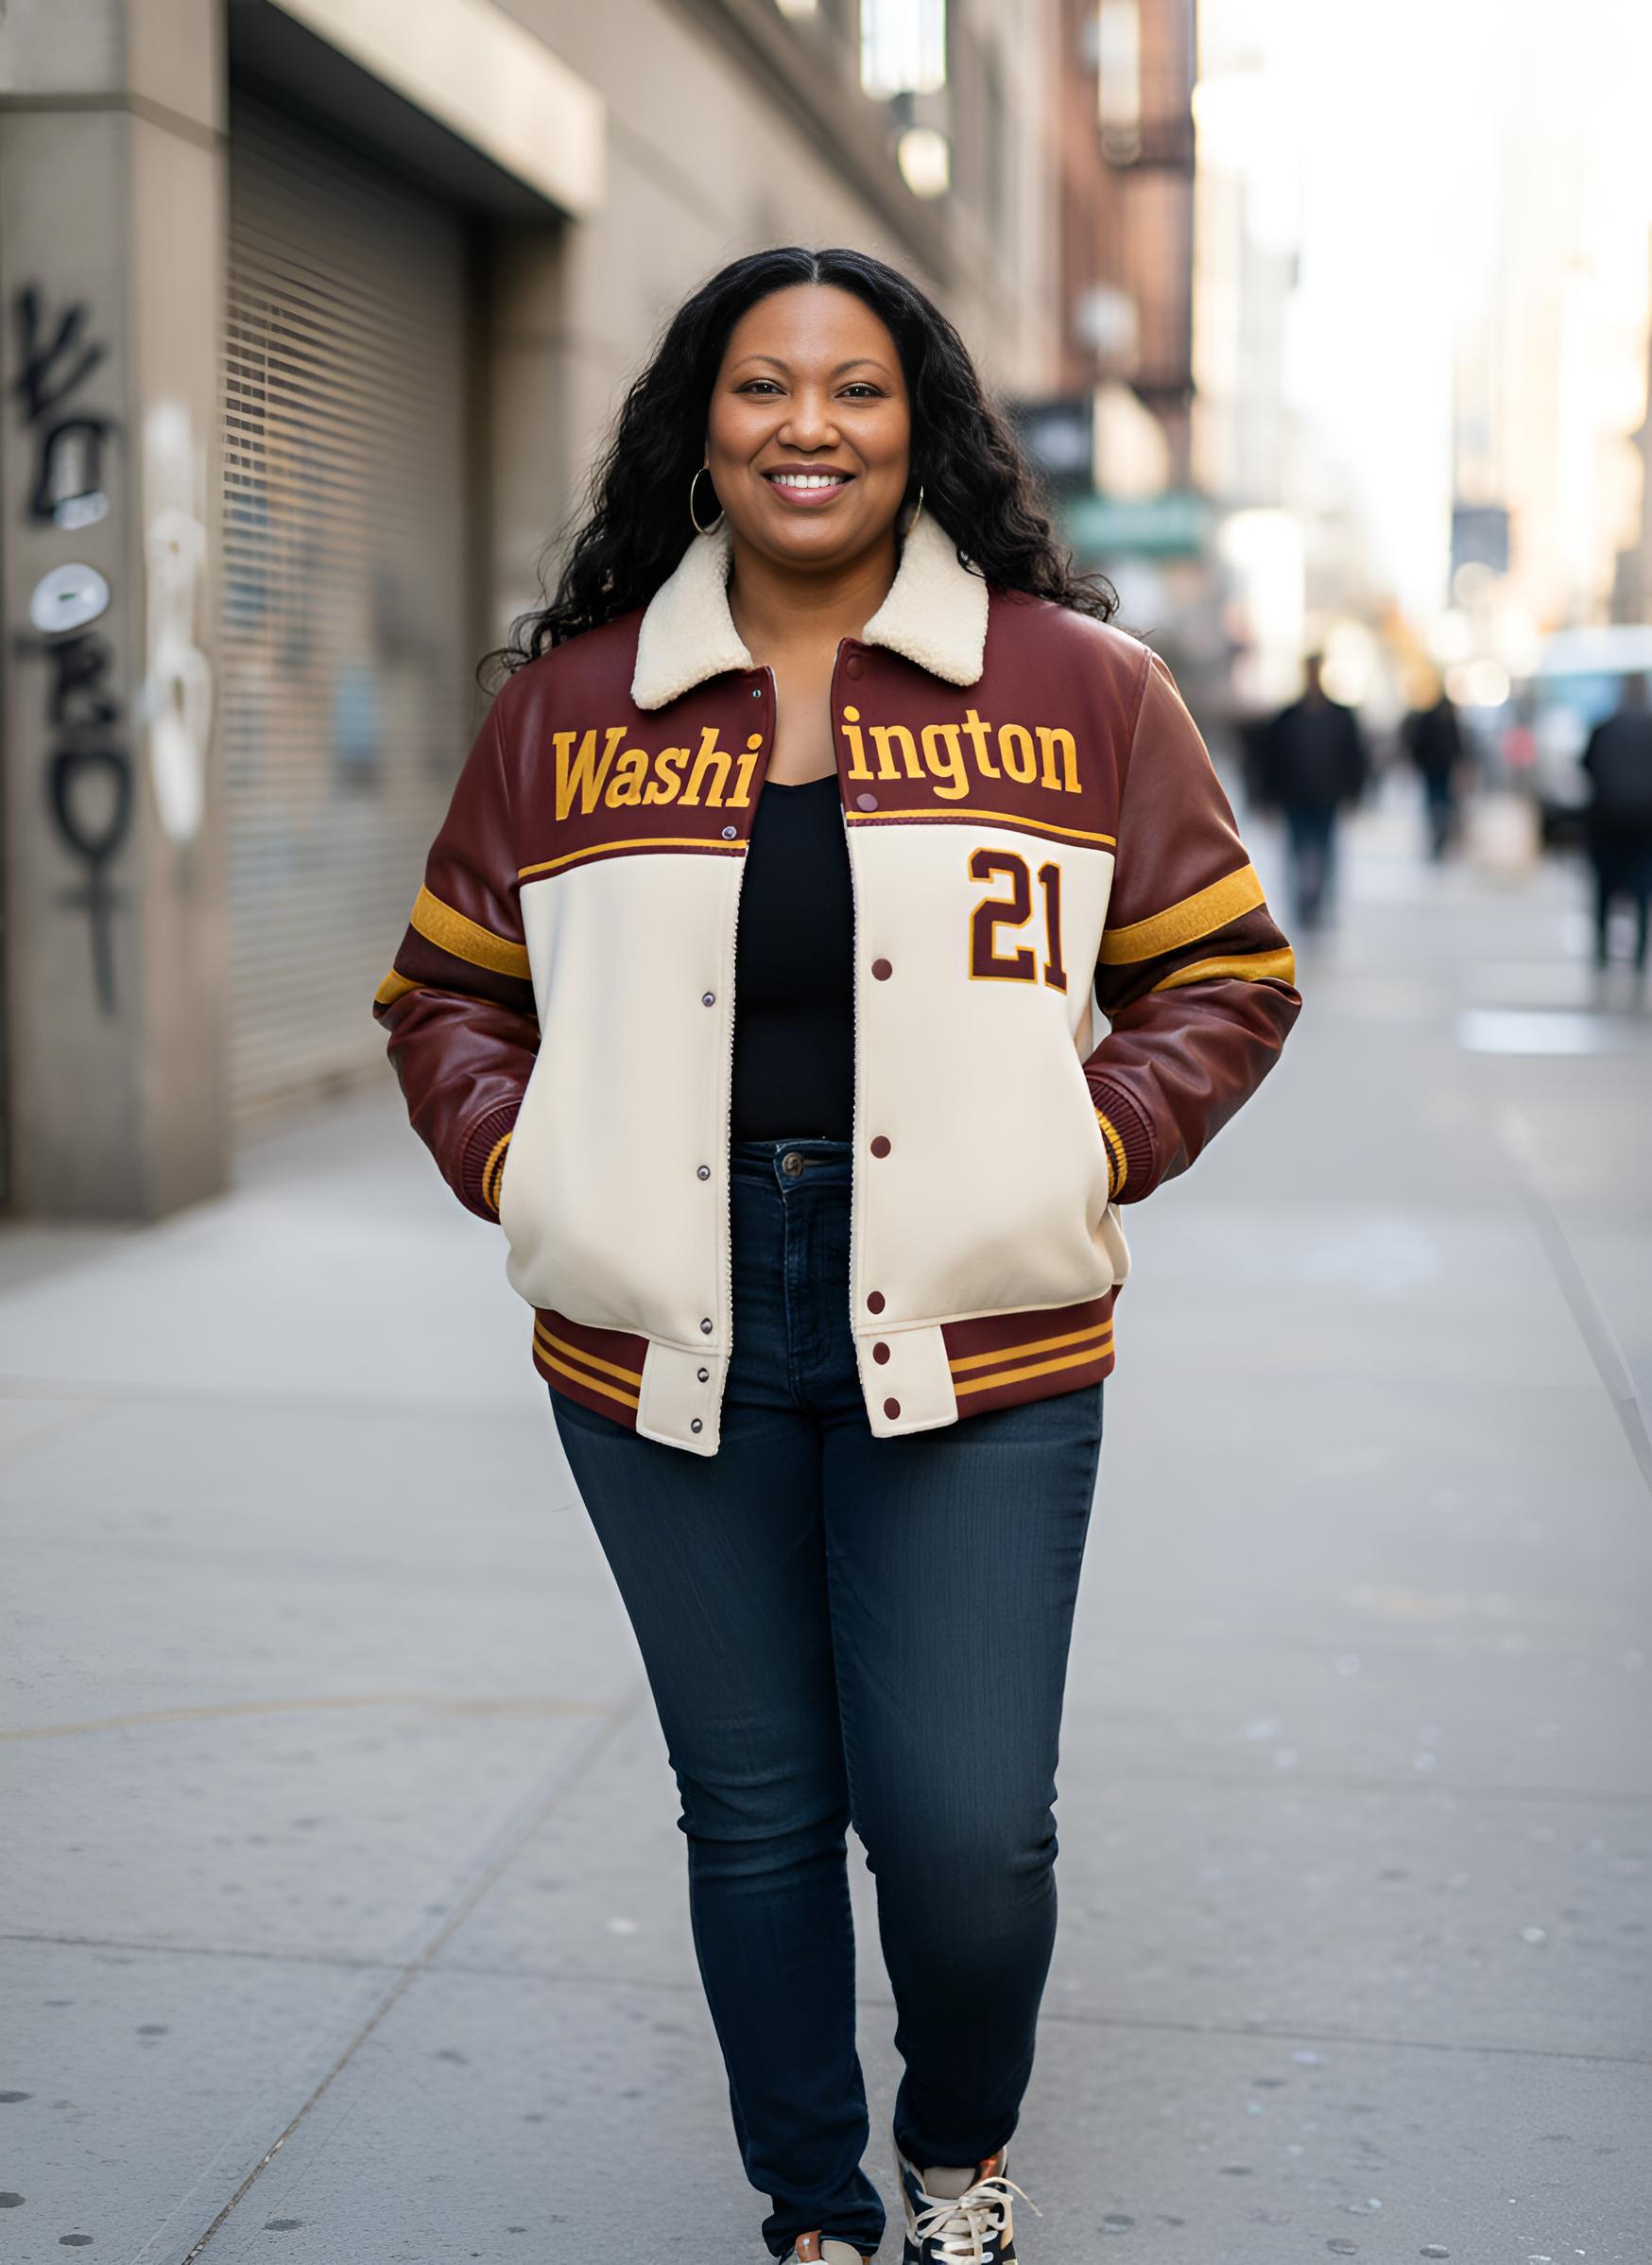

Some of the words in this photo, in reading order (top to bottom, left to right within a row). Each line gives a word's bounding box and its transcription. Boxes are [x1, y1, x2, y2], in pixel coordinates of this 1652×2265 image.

[552, 726, 763, 821] Washi
[841, 705, 1082, 800] ington
[968, 847, 1068, 995] 21
